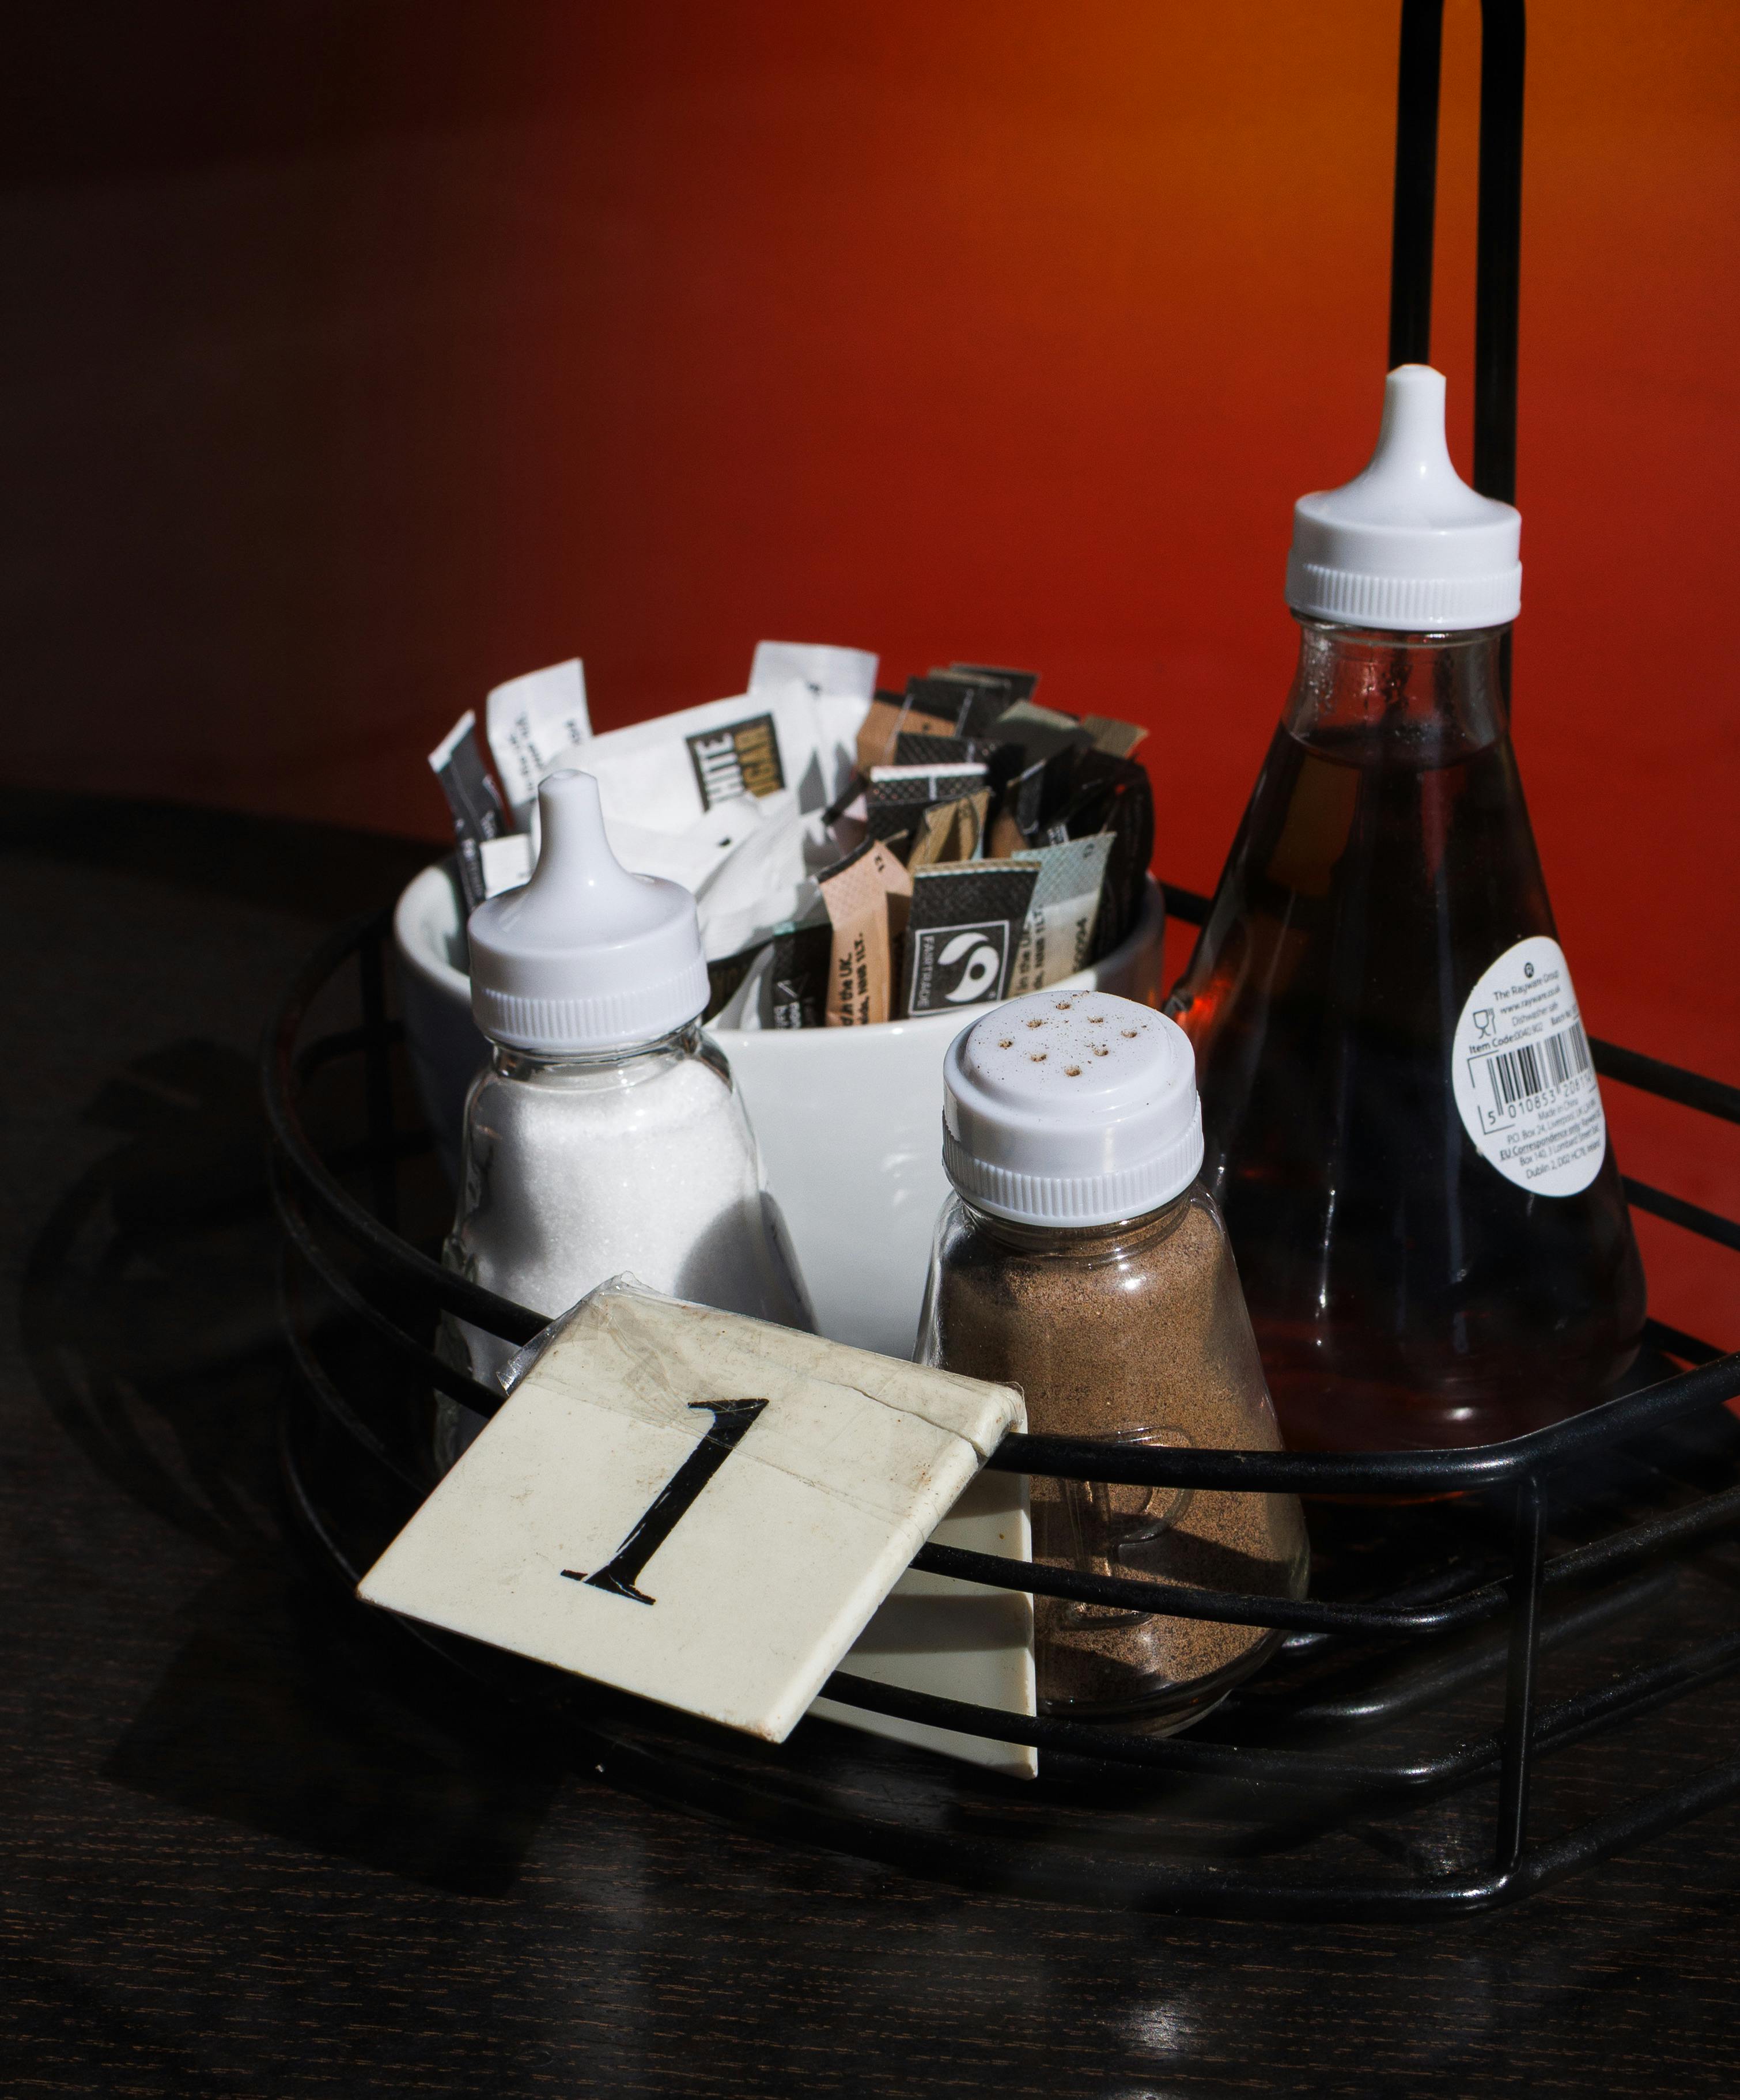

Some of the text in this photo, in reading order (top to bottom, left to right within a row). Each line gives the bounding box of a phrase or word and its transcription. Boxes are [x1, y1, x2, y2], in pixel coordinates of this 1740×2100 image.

[695, 732, 744, 803] HITE
[917, 936, 935, 1007] FAIRTRADE
[839, 979, 853, 1001] the
[1494, 990, 1510, 1001] The
[1511, 978, 1543, 996] Rayware
[1512, 1008, 1548, 1026] Dishwasher
[1469, 1042, 1490, 1054] Item
[1488, 1111, 1496, 1125] 5
[1508, 1089, 1556, 1119] 010853
[1522, 1127, 1535, 1139] Box
[1500, 1149, 1511, 1161] EU
[1520, 1154, 1533, 1166] Box
[1526, 1163, 1550, 1179] Dublin
[561, 1398, 769, 1605] 1
